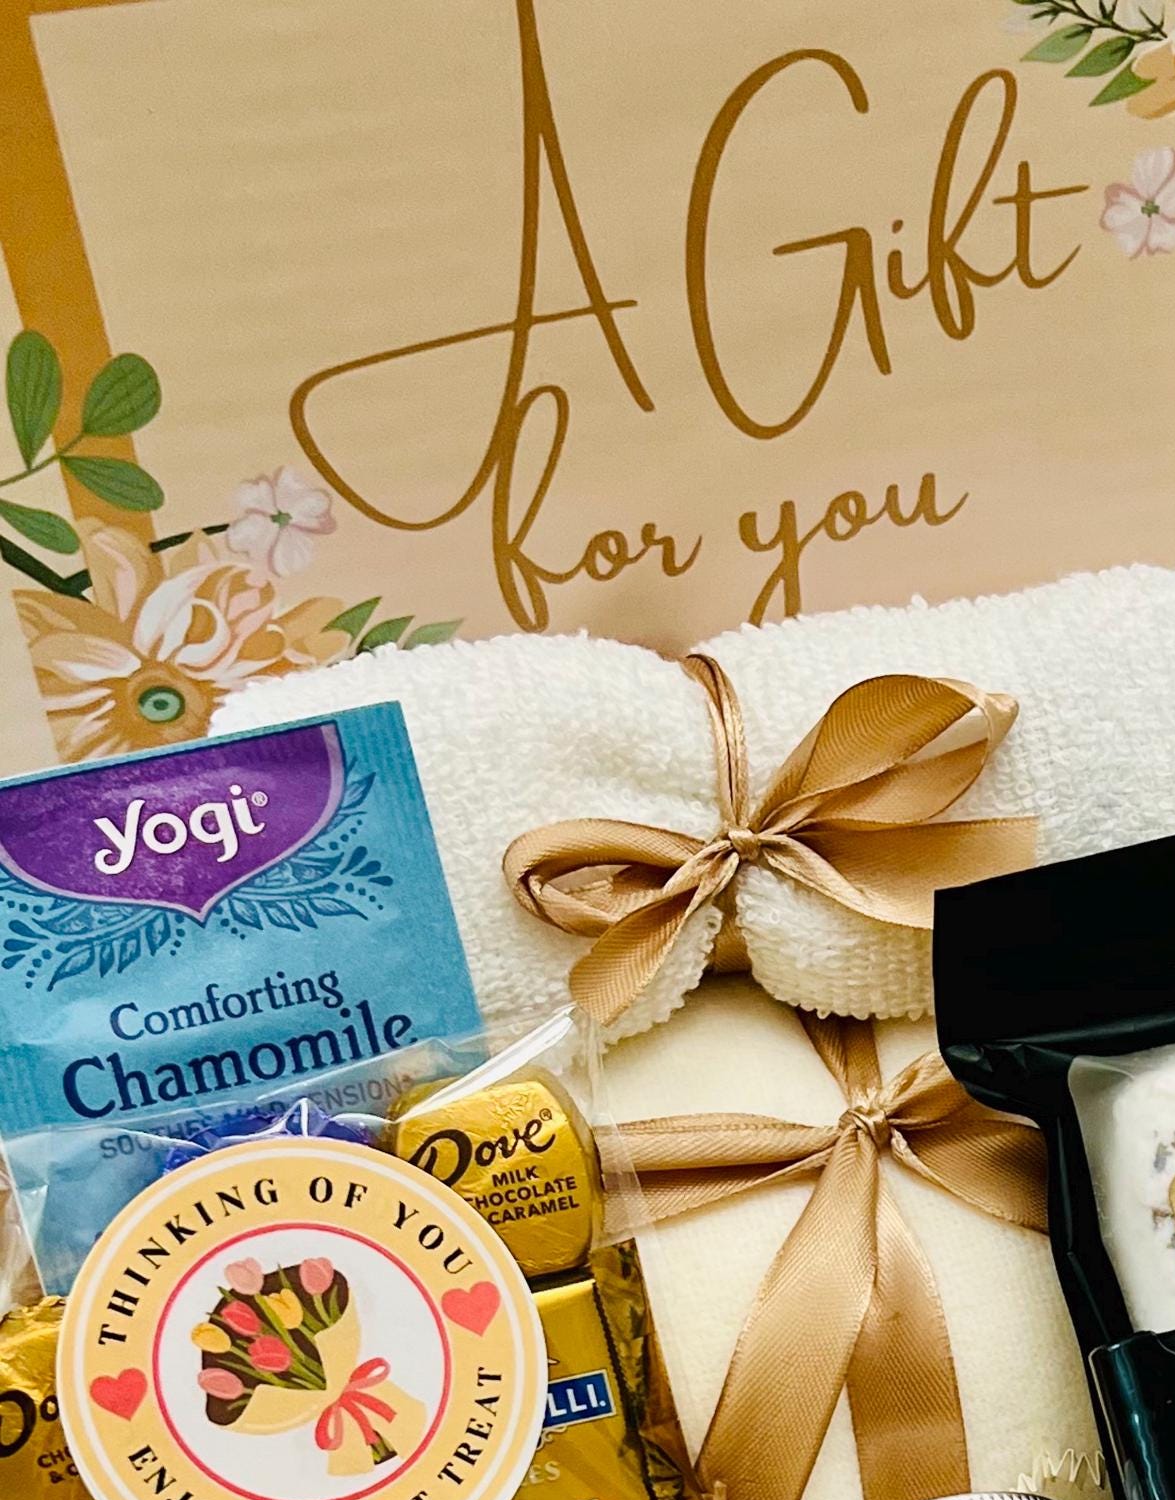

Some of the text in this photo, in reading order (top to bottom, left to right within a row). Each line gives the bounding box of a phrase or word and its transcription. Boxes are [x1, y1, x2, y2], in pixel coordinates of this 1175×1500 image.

[290, 0, 1089, 531] A Gift
[493, 384, 970, 633] for you
[62, 1001, 417, 1119] Chamomile
[110, 970, 343, 1041] Comforting
[488, 1196, 579, 1225] CARAMEL
[492, 1166, 540, 1187] MILK
[98, 1176, 473, 1346] THINKING OF YOU
[437, 1366, 502, 1496] TREAT
